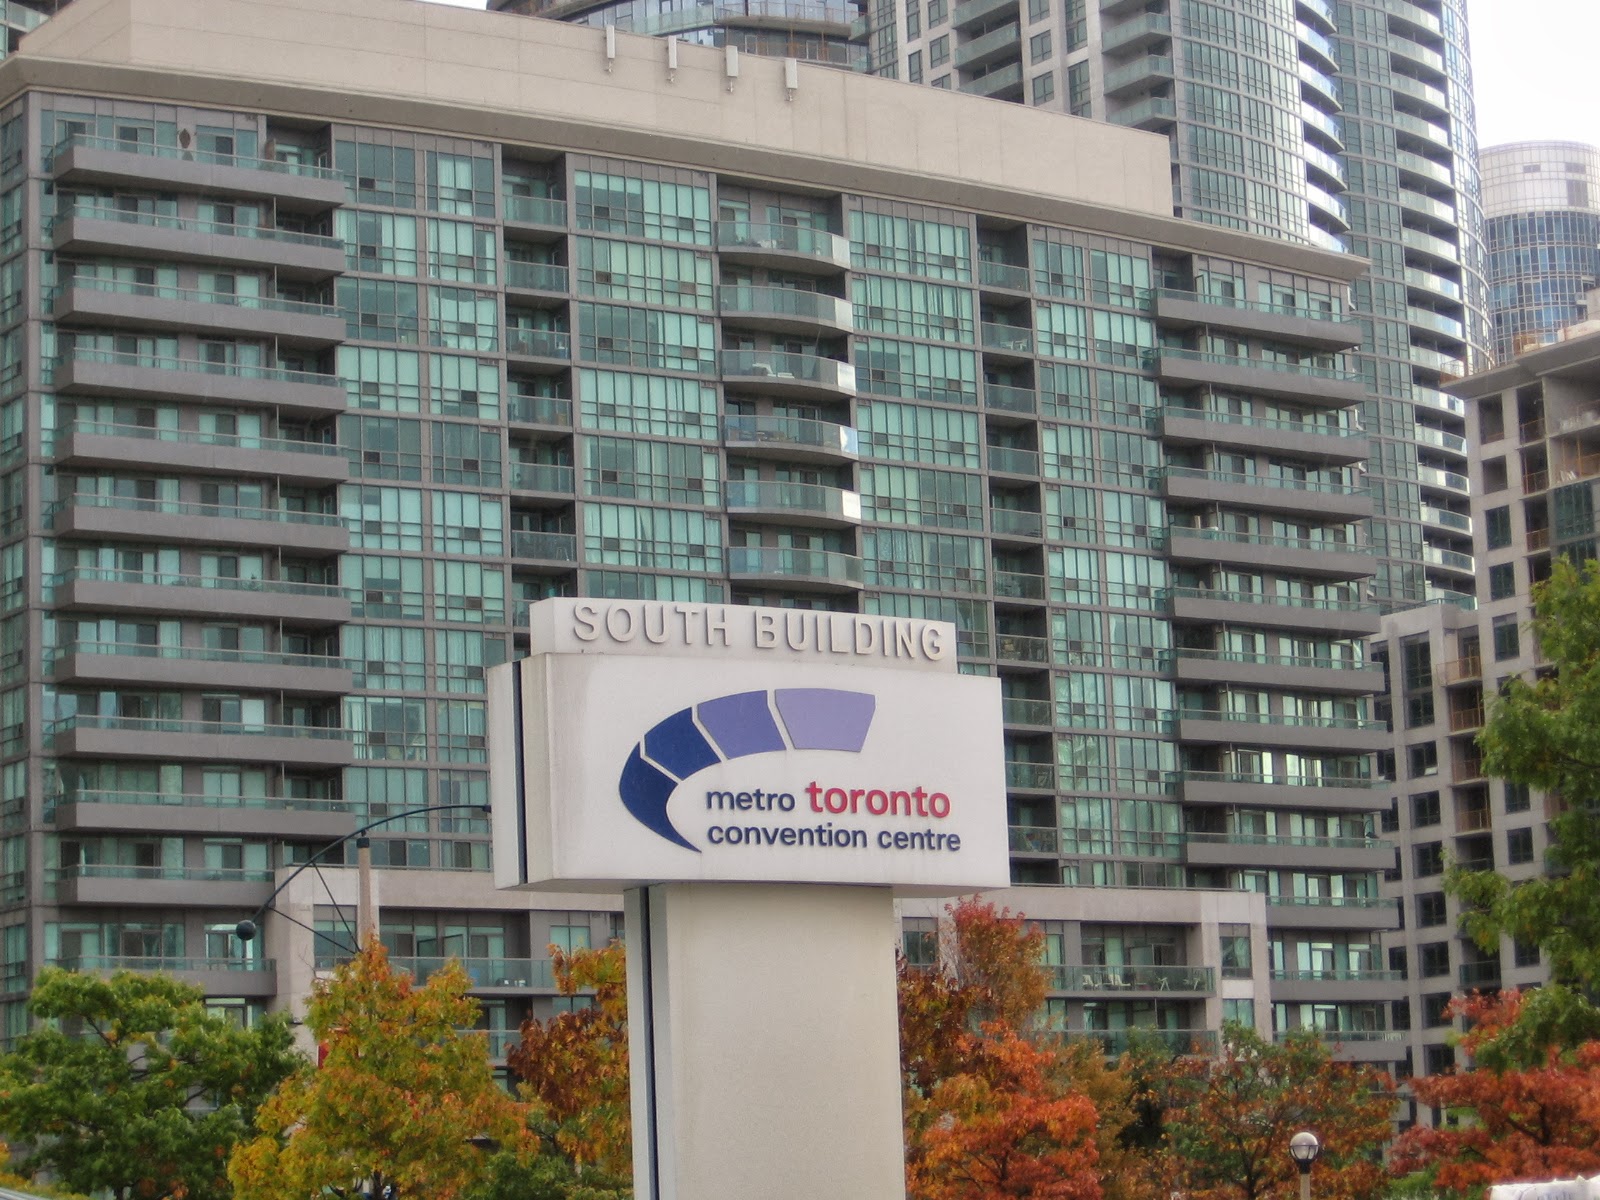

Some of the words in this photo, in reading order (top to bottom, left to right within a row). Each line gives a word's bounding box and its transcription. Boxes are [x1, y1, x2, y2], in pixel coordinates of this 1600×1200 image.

[573, 603, 731, 647] SOUTH
[754, 609, 945, 661] BUILDING
[706, 788, 795, 812] metro
[804, 781, 951, 818] toronto
[707, 823, 868, 849] convention
[878, 828, 961, 852] centre
